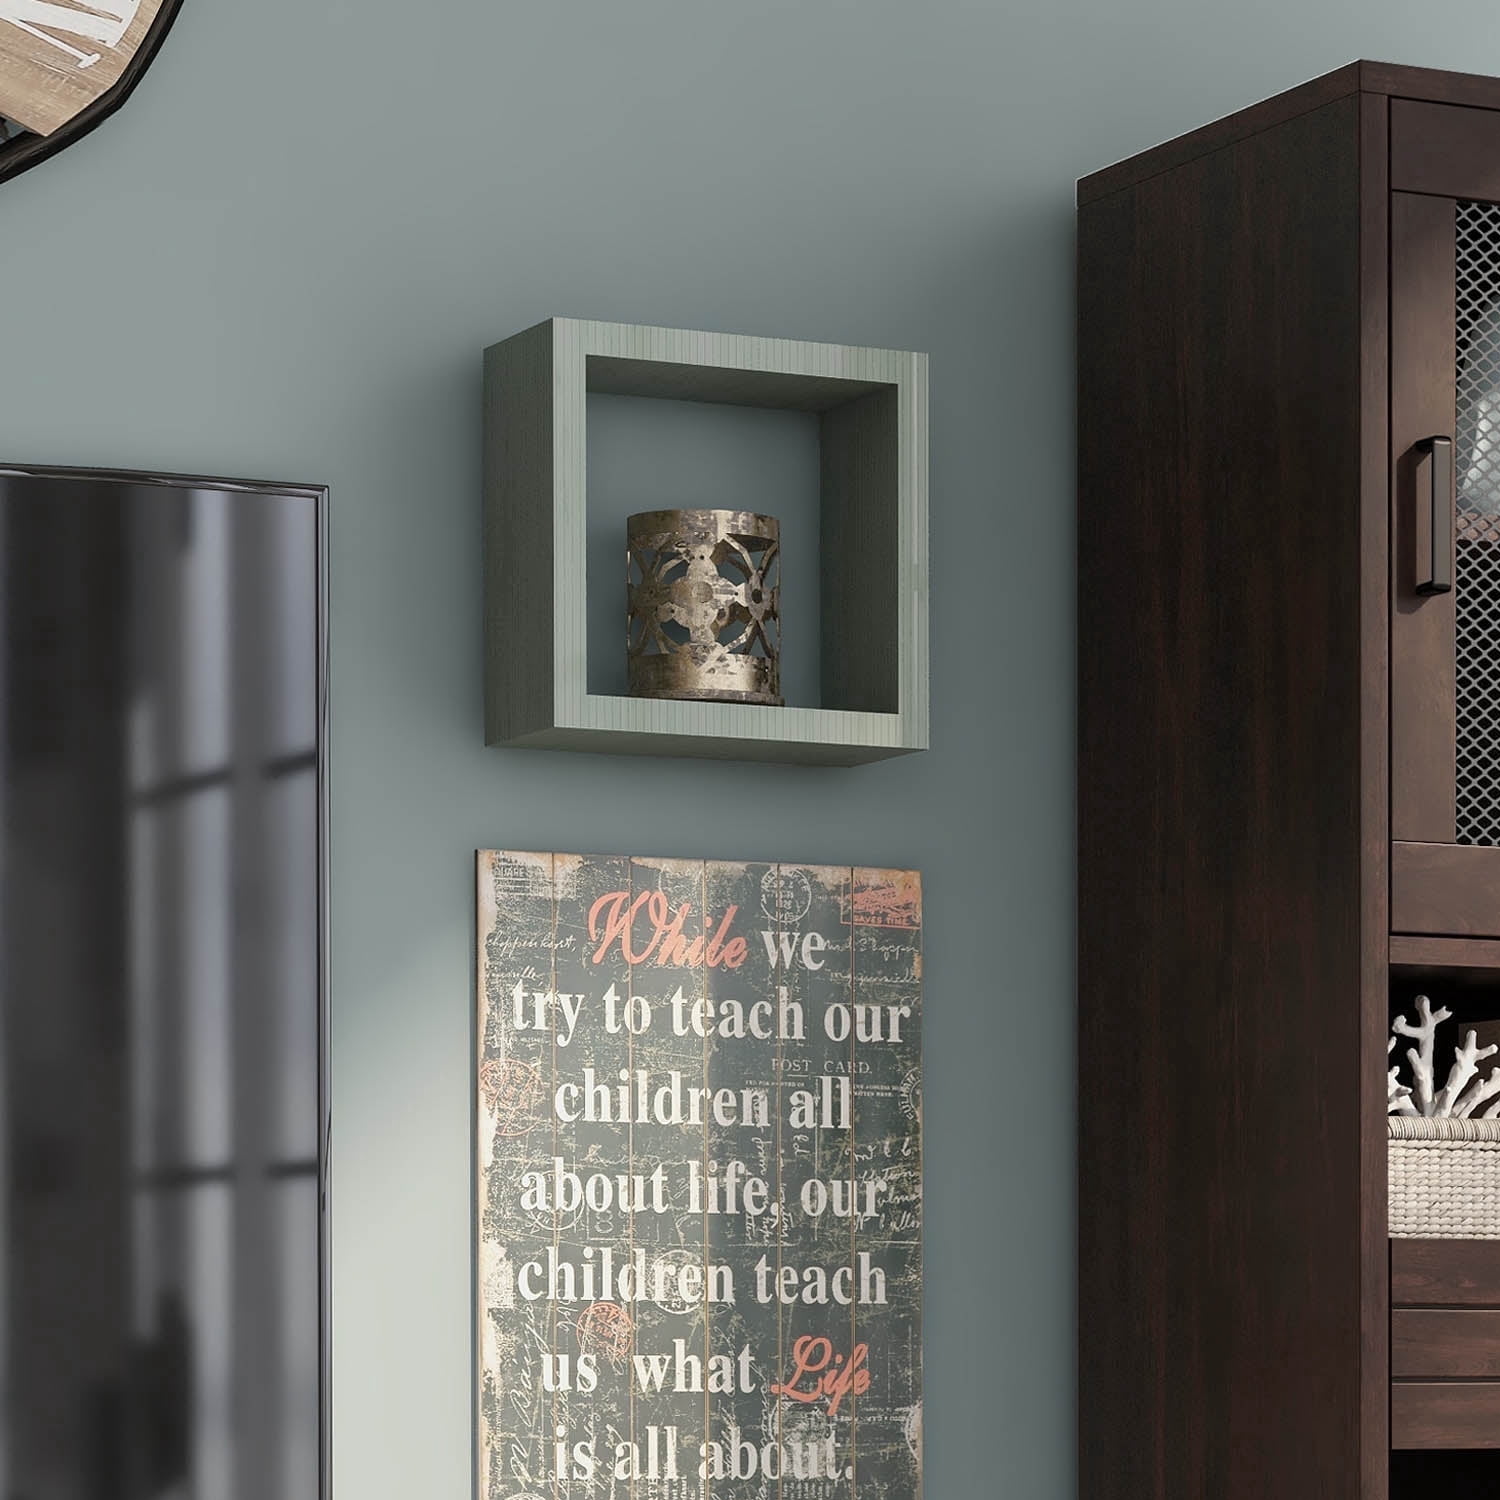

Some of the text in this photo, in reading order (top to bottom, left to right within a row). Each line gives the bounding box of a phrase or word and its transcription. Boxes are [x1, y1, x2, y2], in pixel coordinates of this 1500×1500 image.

[587, 890, 749, 969] While
[761, 931, 825, 971] we
[512, 979, 911, 1048] try to teach our
[771, 1058, 813, 1072] POST
[554, 1068, 771, 1128] children
[789, 1075, 852, 1129] all
[520, 1156, 669, 1215] about
[800, 1178, 887, 1217] our
[518, 1246, 888, 1306] children teach
[541, 1335, 871, 1417] us what Life
[554, 1425, 853, 1482] is all about.
